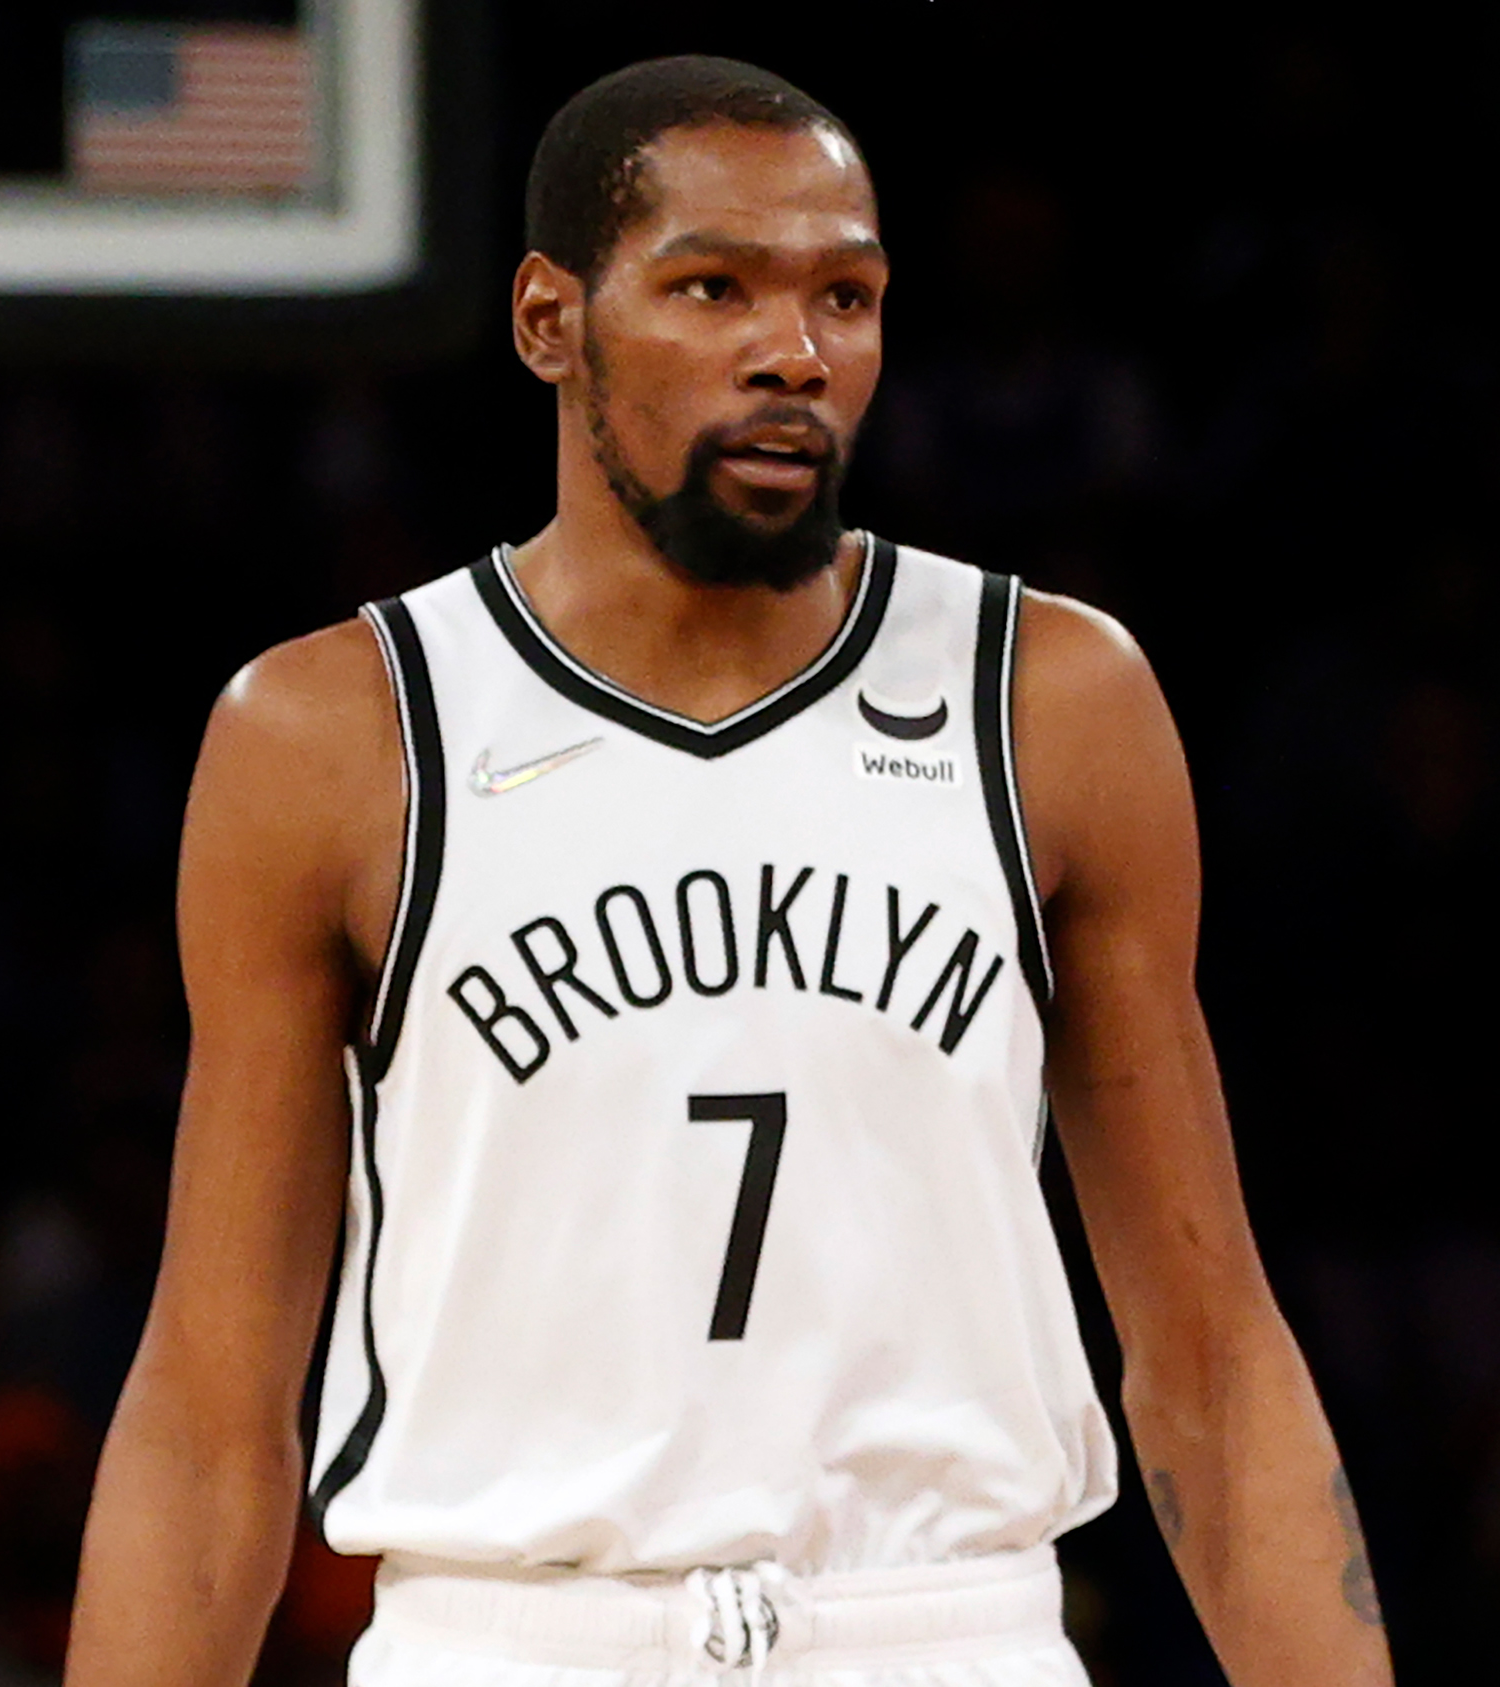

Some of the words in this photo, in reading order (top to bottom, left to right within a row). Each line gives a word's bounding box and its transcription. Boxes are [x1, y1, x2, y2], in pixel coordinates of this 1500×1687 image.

[860, 750, 953, 782] Webull
[446, 863, 1005, 1086] BROOKLYN
[687, 1091, 788, 1342] 7
